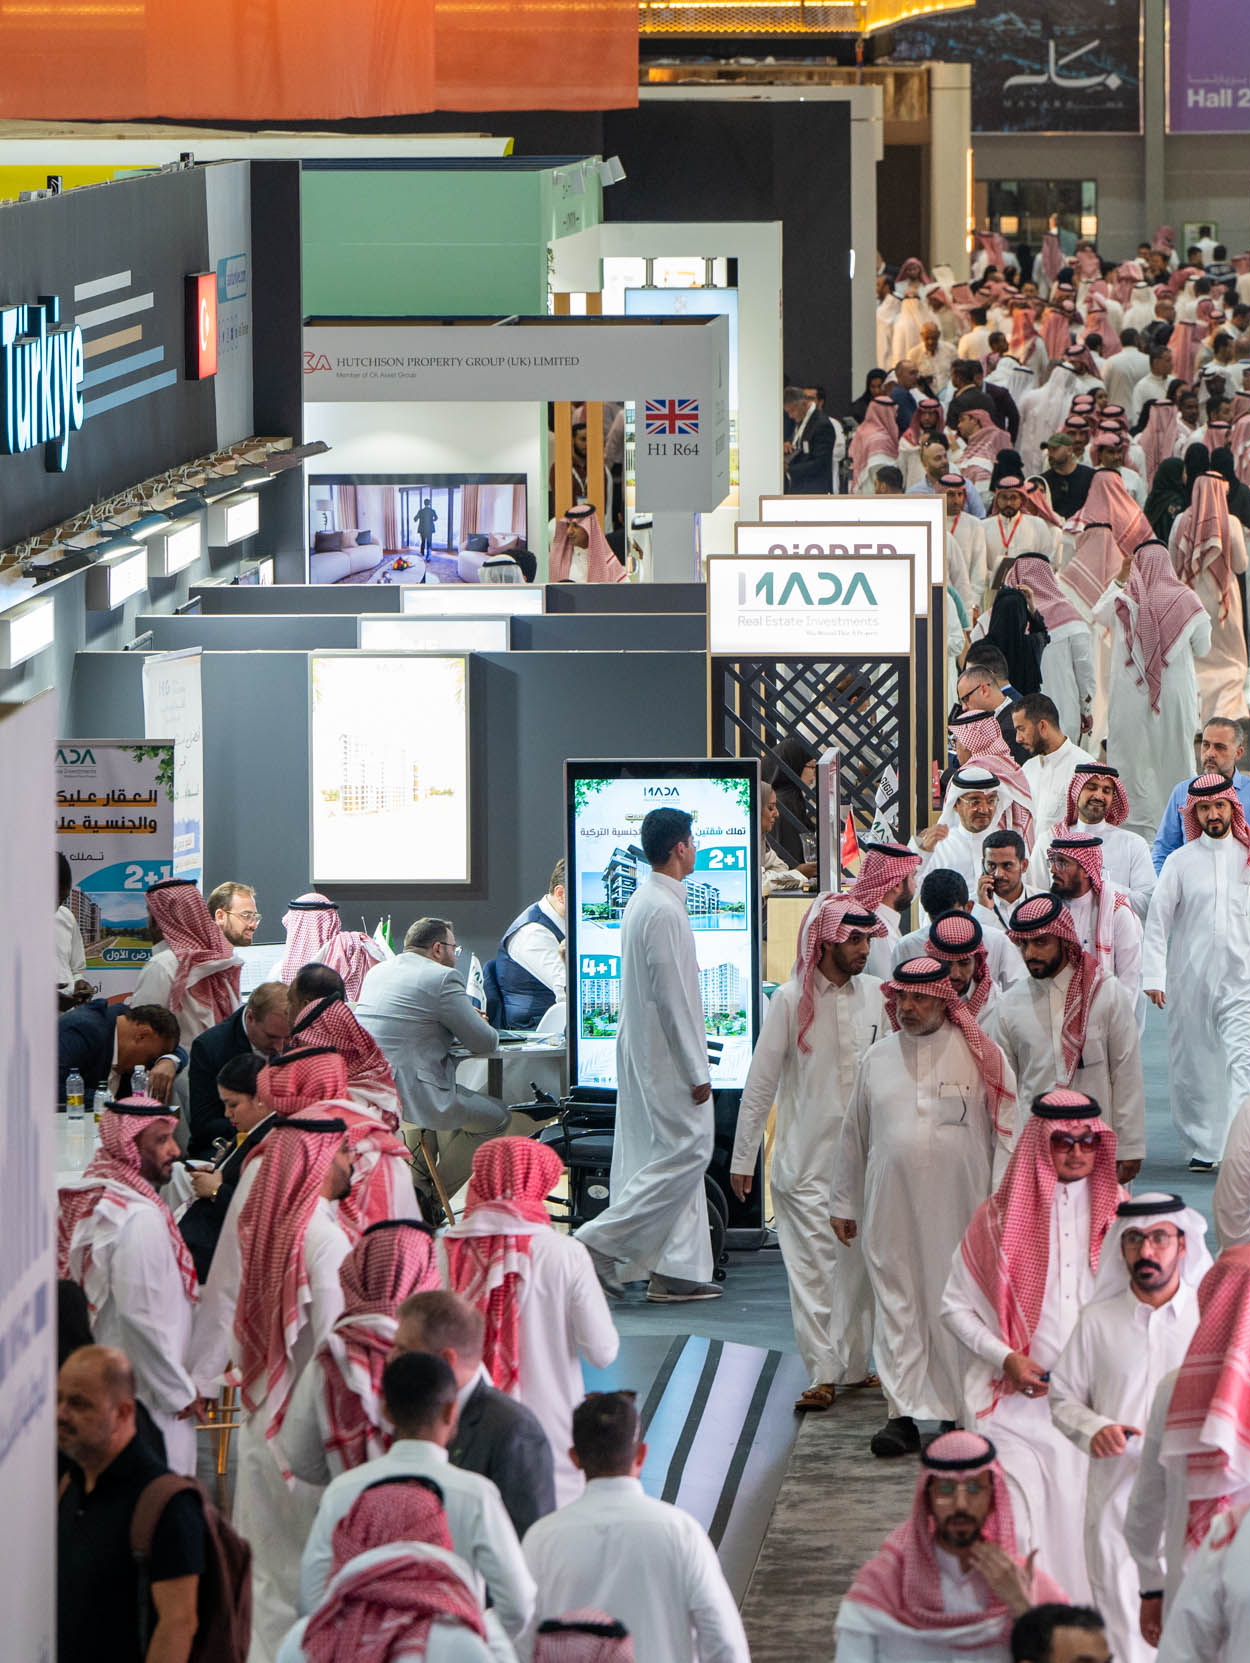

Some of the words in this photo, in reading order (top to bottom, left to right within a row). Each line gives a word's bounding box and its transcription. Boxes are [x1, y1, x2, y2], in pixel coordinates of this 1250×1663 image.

[1187, 88, 1233, 108] Hall
[336, 357, 404, 367] HUTCHISON
[407, 357, 462, 367] PROPERTY
[465, 356, 505, 367] GROUP
[507, 356, 531, 368] (UK)
[533, 356, 580, 367] LIMITED
[648, 443, 667, 456] H1
[673, 443, 700, 456] R64
[738, 615, 763, 626] Real
[765, 616, 802, 627] Estate
[806, 617, 879, 627] Investments
[56, 748, 97, 764] ADA
[102, 788, 158, 806] العقار
[580, 827, 609, 838] التركية
[708, 848, 745, 869] 2+1
[582, 957, 618, 977] 4+1
